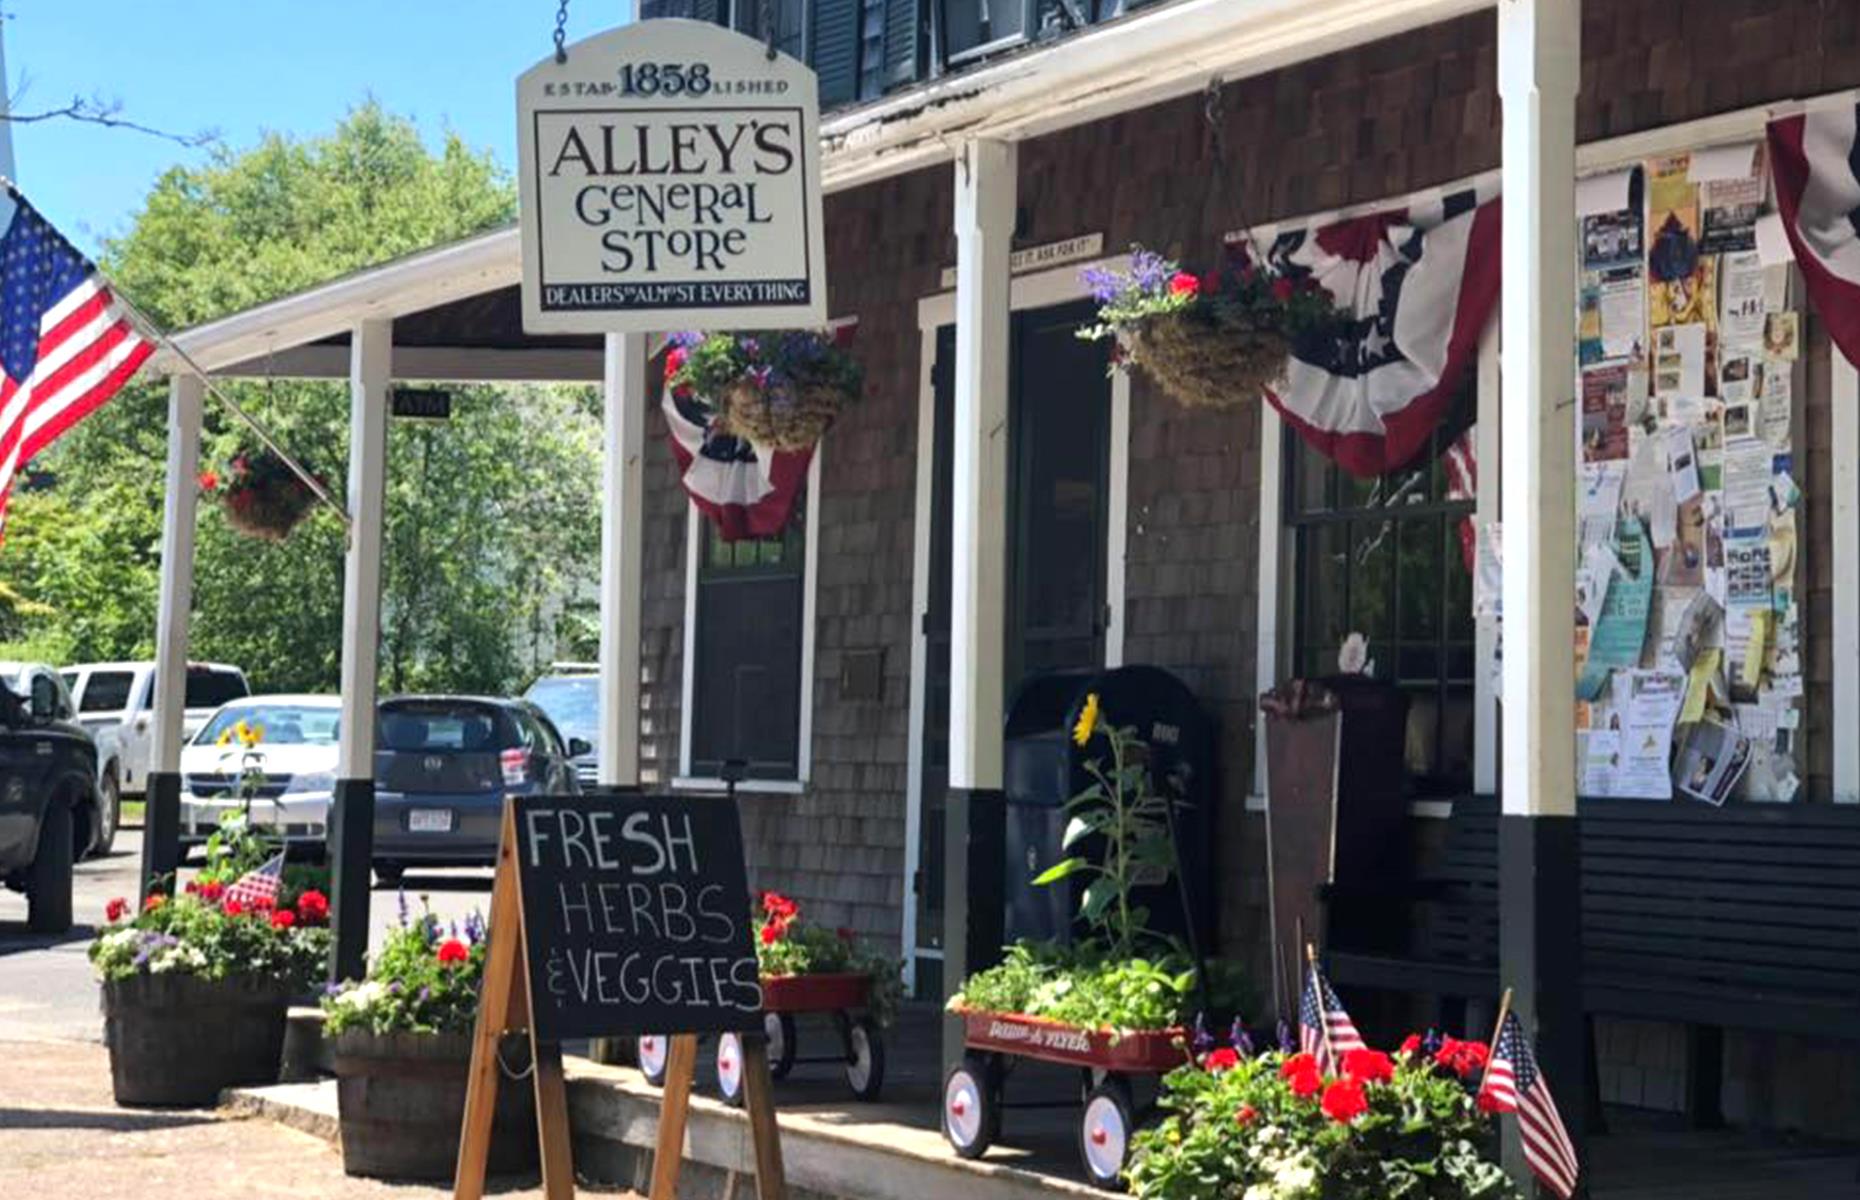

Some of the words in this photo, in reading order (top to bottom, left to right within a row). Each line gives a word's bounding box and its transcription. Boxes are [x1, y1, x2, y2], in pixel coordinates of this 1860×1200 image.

[619, 62, 711, 98] 1858
[714, 79, 789, 96] LISHED
[548, 119, 794, 177] ALLEY'S
[545, 285, 624, 305] DEALERS
[701, 282, 805, 302] EVERYTHING
[526, 809, 698, 874] FRESH
[559, 883, 735, 943] HERBS
[567, 949, 764, 1011] VEGGIES
